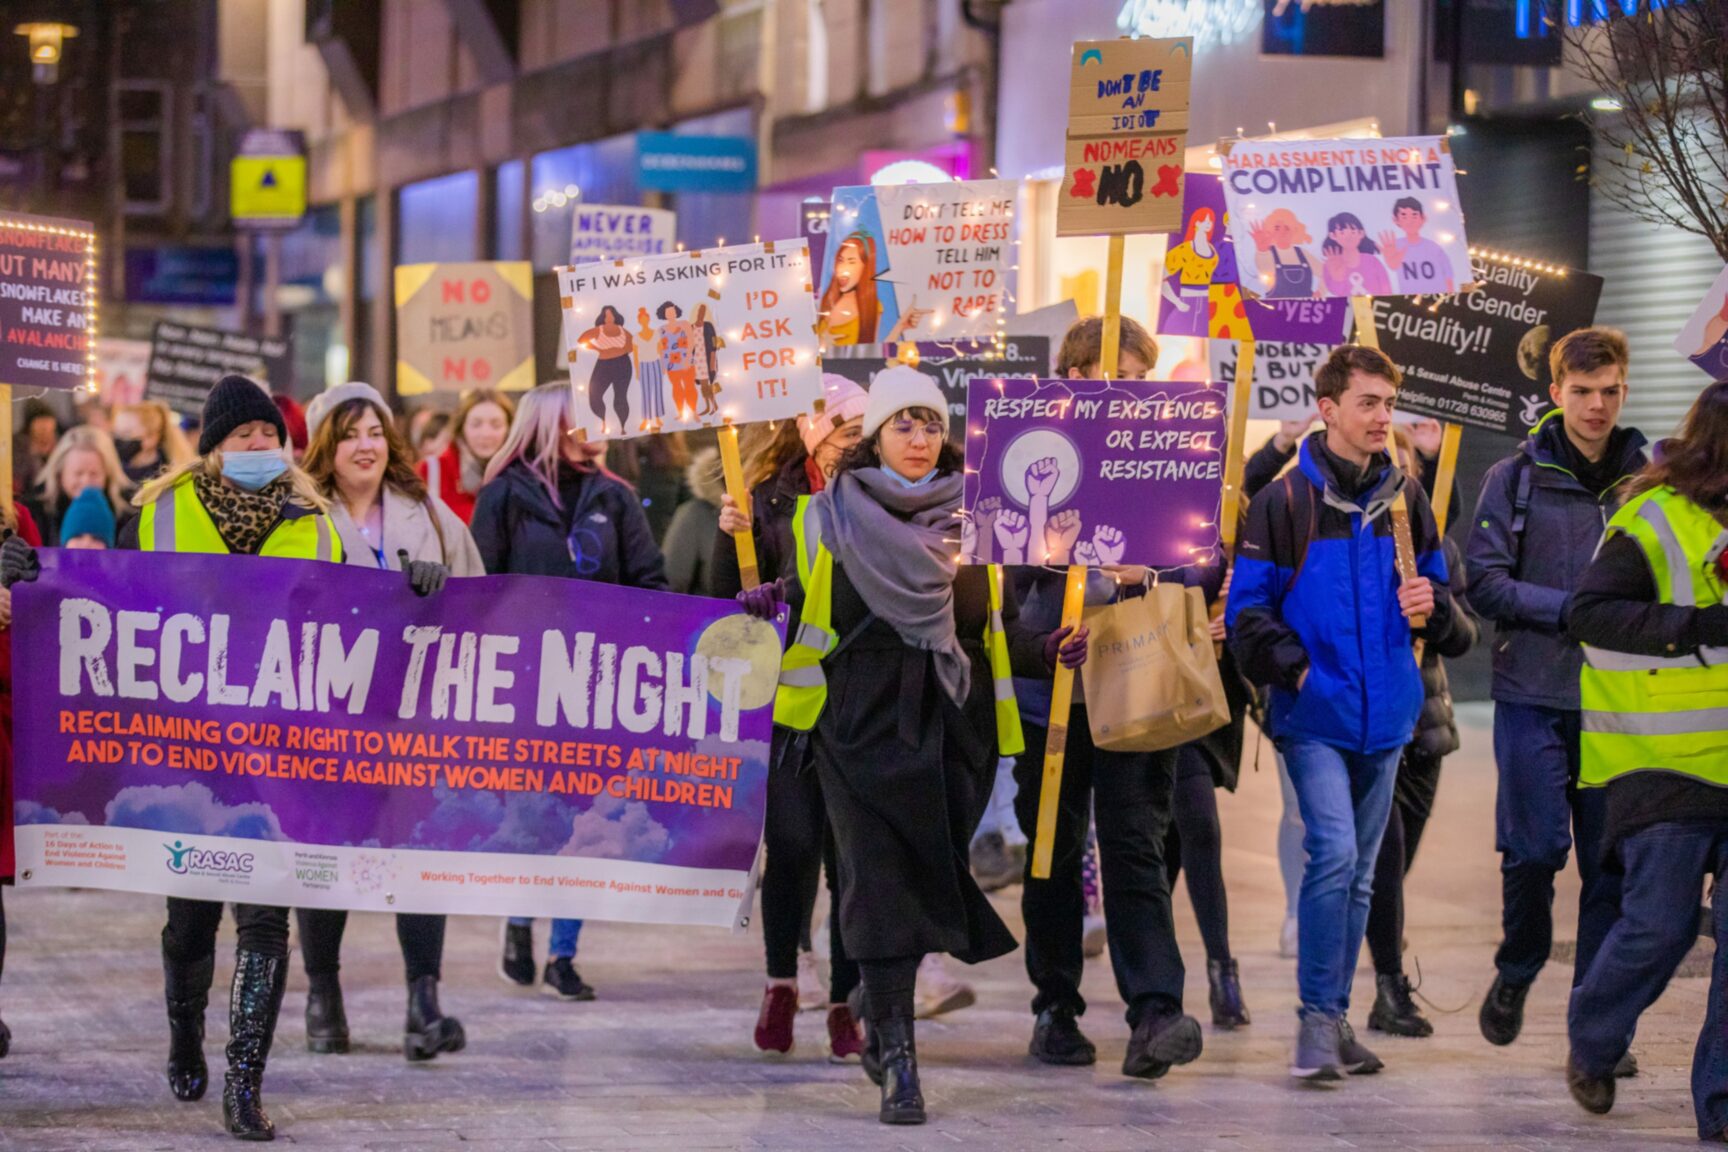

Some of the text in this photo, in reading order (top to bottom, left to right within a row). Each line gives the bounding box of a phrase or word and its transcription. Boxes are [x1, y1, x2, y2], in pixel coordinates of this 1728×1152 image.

[1137, 69, 1163, 93] BE
[1122, 93, 1145, 109] AN
[1112, 110, 1161, 130] IDIOT
[1226, 150, 1355, 169] HARASSMENT
[1360, 149, 1378, 165] IS
[1426, 148, 1441, 163] A
[1096, 160, 1145, 208] NO
[1230, 163, 1441, 195] COMPLIMENT
[579, 212, 652, 234] NEVER
[888, 222, 1009, 245] HOW TO DRESS
[936, 246, 1000, 264] TELL HIM
[0, 254, 84, 284] UT MANY
[570, 278, 586, 293] IF
[592, 277, 597, 290] I
[603, 271, 647, 288] WAS
[653, 262, 721, 283] ASKING
[727, 257, 765, 274] FOR
[928, 269, 996, 290] NOT TO
[1402, 260, 1436, 280] NO
[0, 282, 86, 306] SNOWFLAKES
[442, 279, 491, 304] NO
[745, 290, 779, 310] I'D
[952, 294, 998, 317] RAPE
[1467, 288, 1548, 326] Gender
[22, 306, 86, 329] MAKE AN
[430, 312, 508, 343] MEANS
[1372, 300, 1492, 355] Equality!!
[740, 318, 793, 342] ASK
[17, 358, 50, 371] CHANGE
[52, 361, 59, 372] IS
[443, 357, 493, 382] NO
[742, 347, 795, 371] FOR
[1267, 360, 1317, 380] BUT
[756, 378, 788, 399] IT!
[1406, 365, 1415, 376] &
[1416, 366, 1449, 383] Sexual
[1449, 374, 1480, 391] Abuse
[1480, 382, 1512, 399] Centre
[1398, 387, 1436, 406] Helpline
[984, 398, 1070, 420] RESPECT
[1074, 400, 1103, 420] MY
[1107, 400, 1217, 420] EXISTENCE
[1105, 430, 1217, 451] OR EXPECT
[1100, 459, 1220, 481] RESISTANCE
[59, 598, 752, 743] RECLAIM THE NIGHT
[59, 710, 742, 780] RECLAIMING OUR RIGHT TO WALK THE STREETS AT NIGHT
[66, 740, 733, 809] AND TO END VIOLENCE AGAINST WOMEN AND CHILDREN
[57, 841, 77, 849] Days
[89, 842, 113, 850] Action
[115, 843, 124, 851] to
[63, 850, 97, 858] Violence
[98, 852, 126, 861] Against
[45, 859, 75, 867] Women
[94, 861, 126, 870] Children
[188, 849, 254, 873] RASAC
[295, 868, 338, 882] WOMEN
[420, 871, 464, 885] Working
[467, 872, 516, 886] Together
[519, 874, 530, 885] to
[533, 875, 554, 886] End
[557, 876, 606, 889] Violence
[609, 880, 651, 894] Against
[655, 884, 699, 896] Women
[702, 887, 724, 897] and
